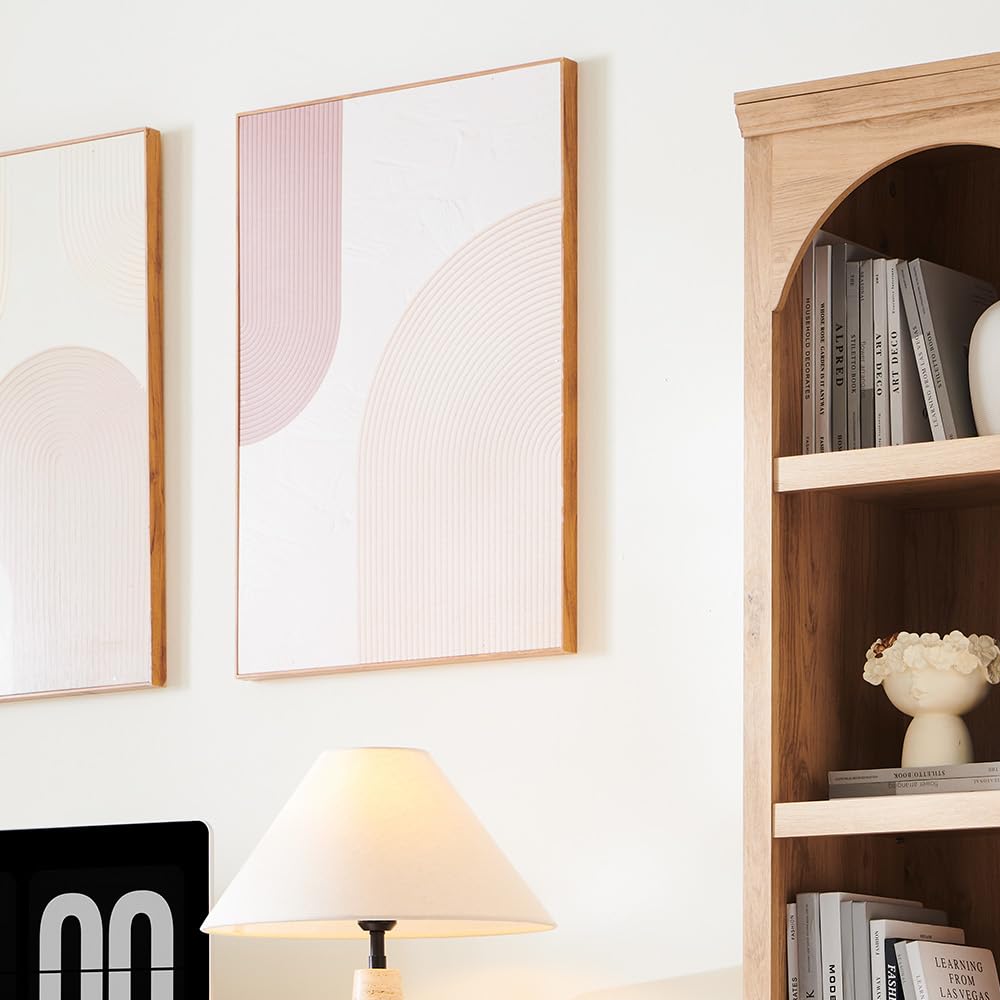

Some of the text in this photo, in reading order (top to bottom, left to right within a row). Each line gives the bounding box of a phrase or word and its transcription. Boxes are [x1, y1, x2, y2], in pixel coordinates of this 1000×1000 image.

[912, 326, 921, 350] VEGAS
[836, 323, 844, 387] ALPRED
[891, 331, 900, 394] ART DECO
[926, 330, 942, 388] STILETTO BOOK
[922, 368, 930, 388] FROM
[926, 390, 939, 428] LEARNING
[914, 770, 946, 778] STILETTO
[934, 956, 984, 972] LEARNING
[948, 973, 976, 986] FROM
[940, 987, 958, 999] LAS
